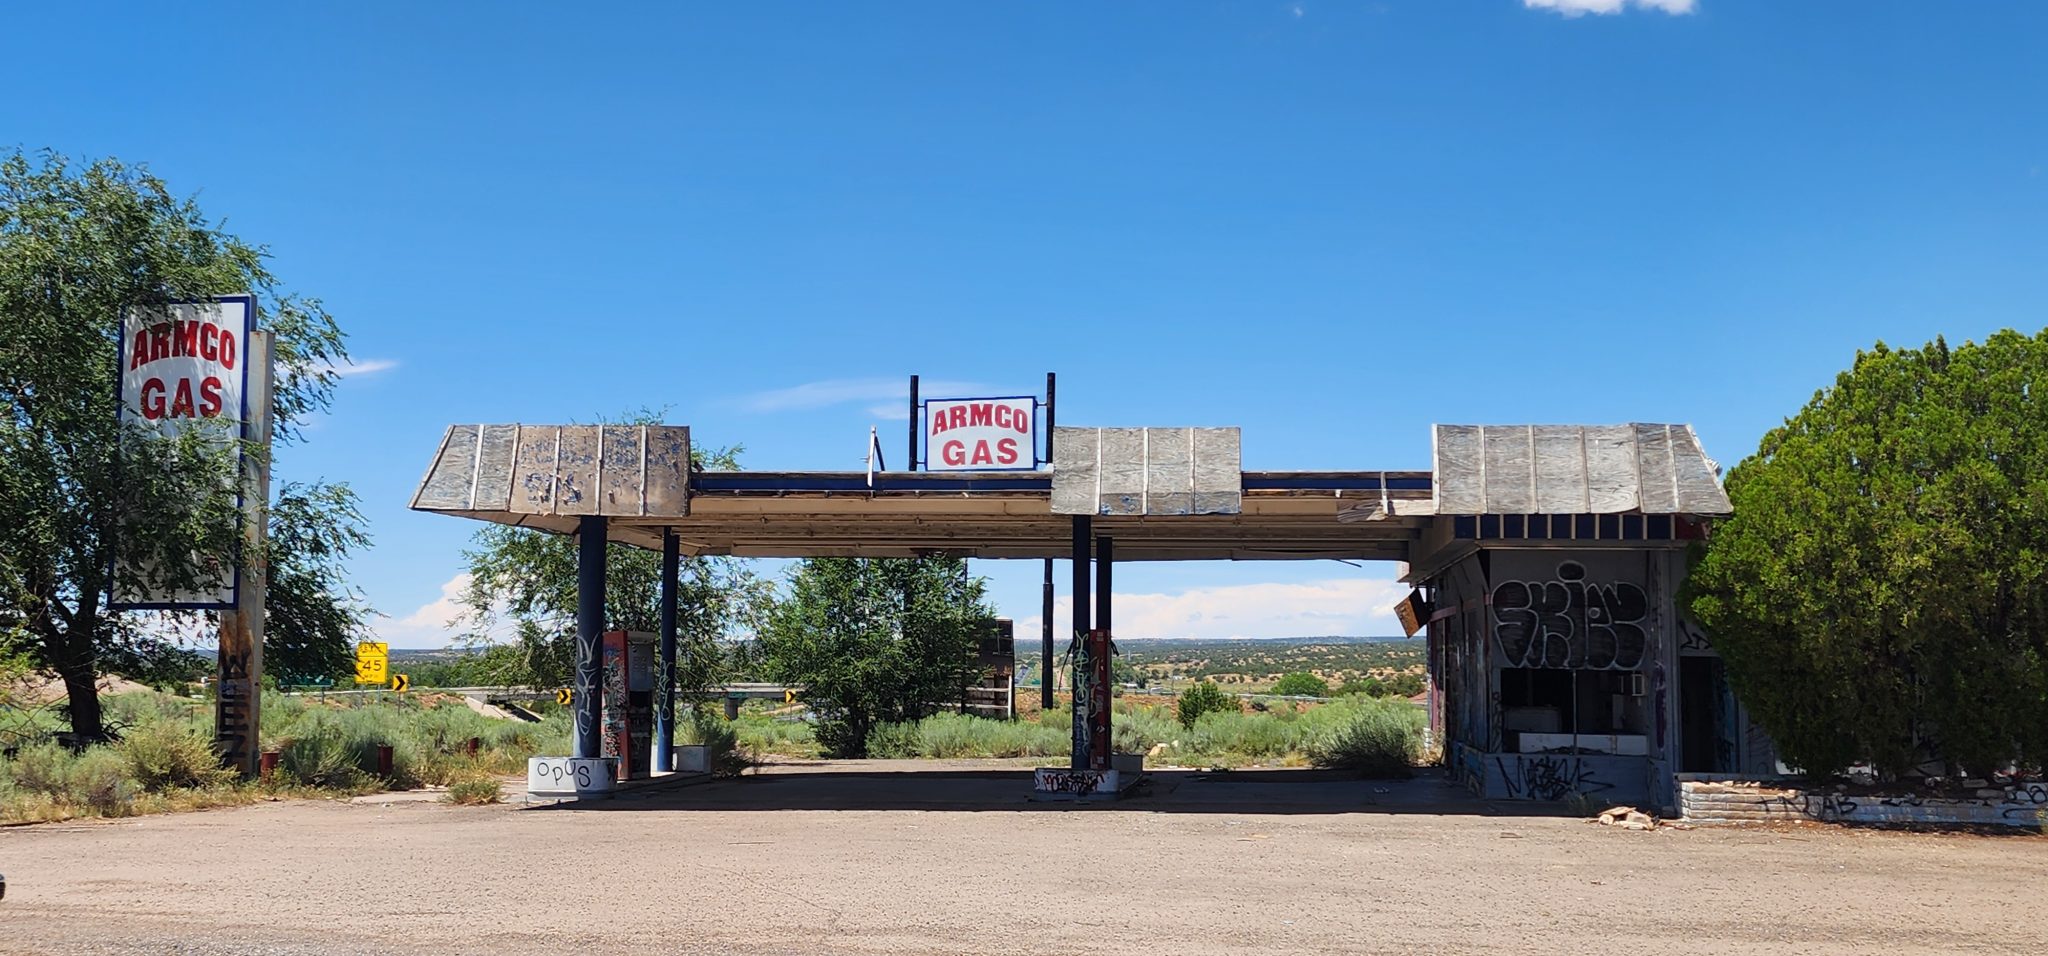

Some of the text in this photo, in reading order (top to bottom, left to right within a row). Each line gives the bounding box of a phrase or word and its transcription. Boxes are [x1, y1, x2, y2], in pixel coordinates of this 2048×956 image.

[131, 320, 235, 371] ARMCO
[140, 376, 222, 420] GAS
[932, 403, 1028, 436] ARMCO
[942, 438, 1018, 466] GAS
[362, 660, 382, 672] 45
